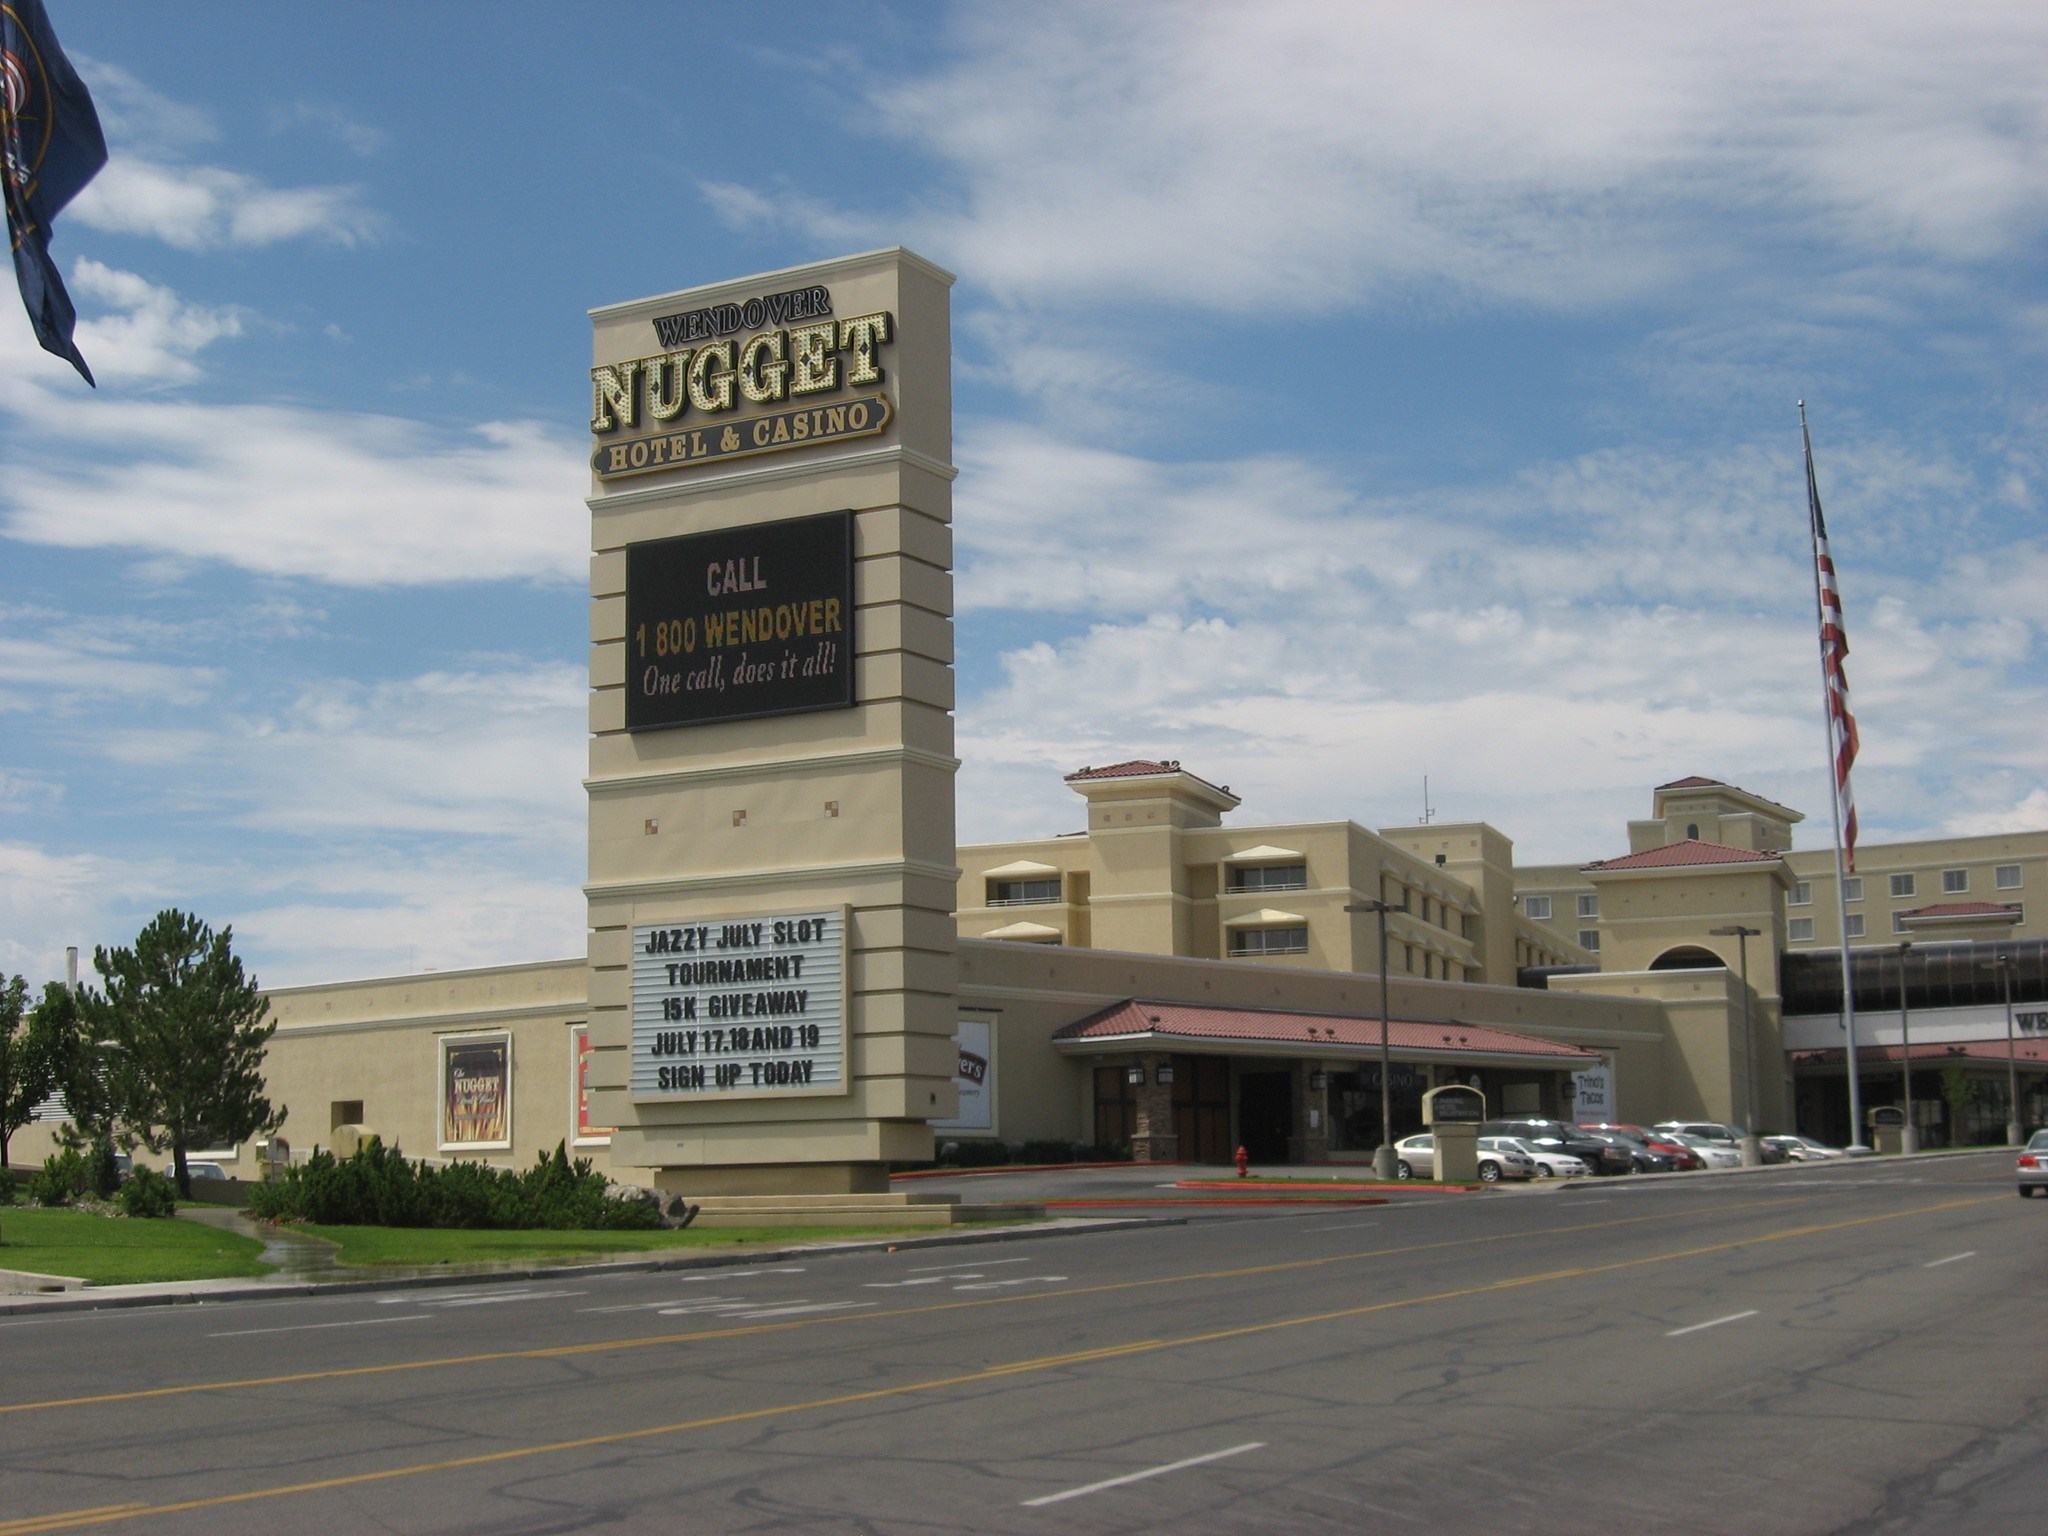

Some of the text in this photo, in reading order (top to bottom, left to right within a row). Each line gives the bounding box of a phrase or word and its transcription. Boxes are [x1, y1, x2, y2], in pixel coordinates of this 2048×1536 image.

[652, 285, 831, 346] WENDOVER
[591, 310, 891, 430] NUGGET
[609, 402, 869, 470] HOTEL & CASINO
[706, 556, 768, 597] CALL
[636, 597, 842, 657] 1 800 WENDOVER
[643, 641, 837, 696] One call, does it all!
[645, 918, 826, 954] JAZZY JULY SLOT
[665, 954, 804, 986] TOURNAMENT
[661, 989, 808, 1021] 15K GIVEAWAY
[651, 1030, 697, 1056] JULY
[750, 1025, 793, 1050] AND
[797, 1023, 820, 1048] 19
[454, 1076, 499, 1093] NUGGET
[657, 1059, 813, 1089] SIGN UP TODAY
[958, 1058, 982, 1078] ers
[1372, 1072, 1413, 1087] CSINO
